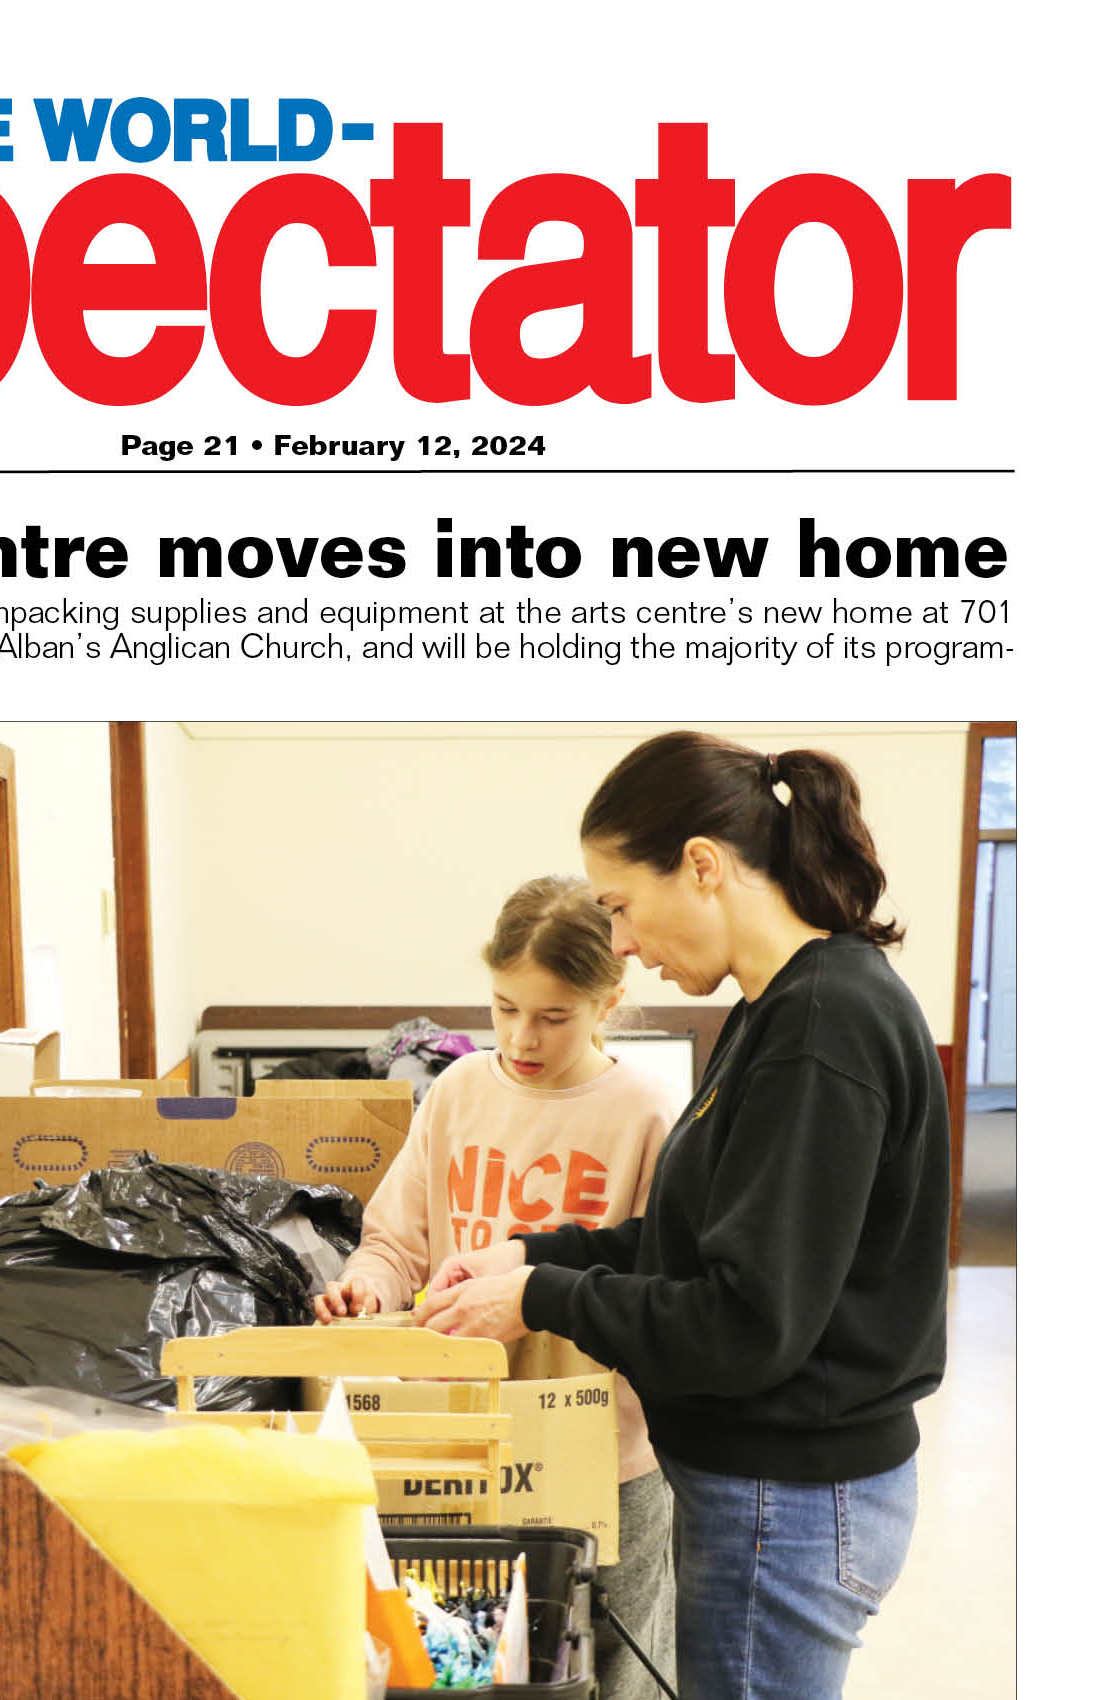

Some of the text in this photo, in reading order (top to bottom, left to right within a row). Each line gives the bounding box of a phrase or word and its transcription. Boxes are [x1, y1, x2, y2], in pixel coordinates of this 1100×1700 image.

[34, 97, 374, 163] WORLD-
[122, 435, 545, 461] Page 21 February 12, 2024
[160, 537, 405, 578] moves
[438, 518, 581, 578] into
[613, 537, 768, 578] new
[800, 518, 1007, 578] home
[132, 598, 246, 631] supplies
[258, 598, 307, 623] and
[321, 602, 468, 631] equipment
[480, 602, 504, 623] at
[517, 598, 561, 623] the
[572, 602, 625, 623] arts
[765, 607, 822, 623] new
[834, 598, 912, 623] home
[923, 602, 948, 623] at
[961, 600, 1007, 623] 701
[451, 1216, 492, 1253] TO
[539, 1392, 556, 1409] 12
[576, 1388, 609, 1407] 500g
